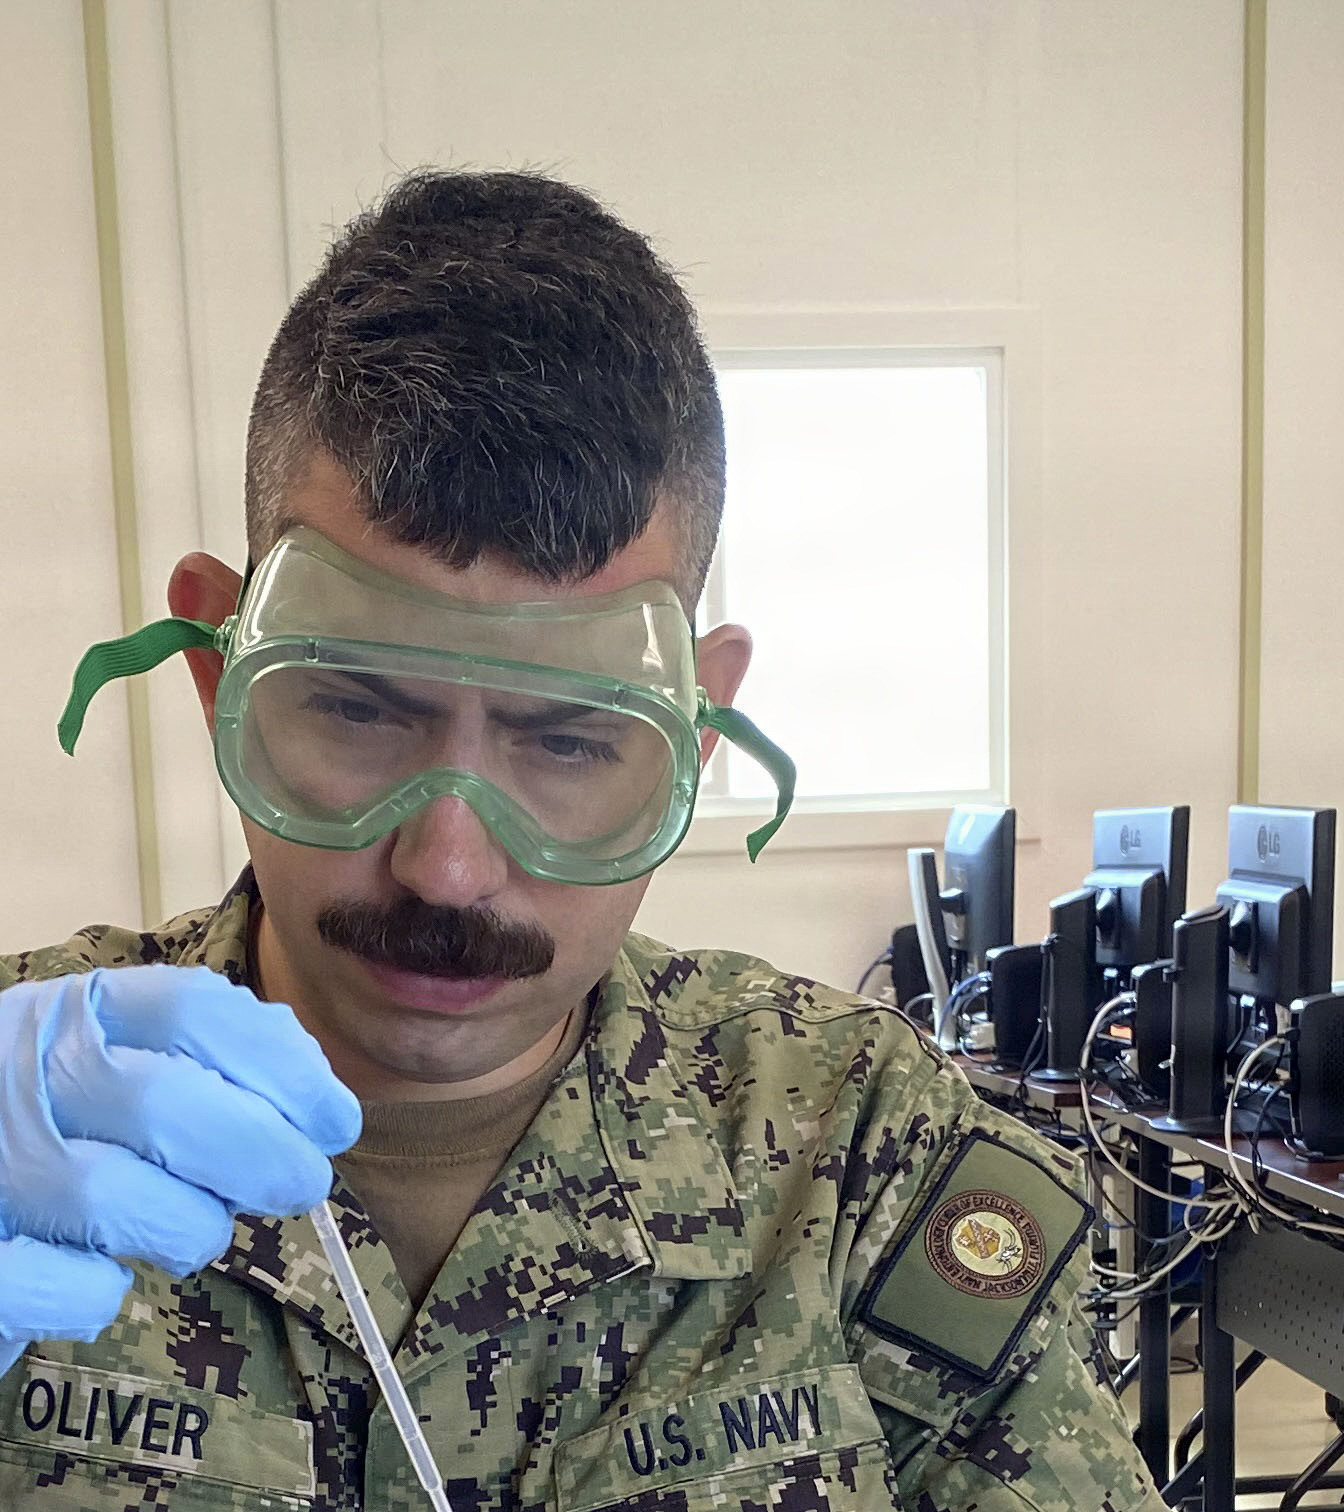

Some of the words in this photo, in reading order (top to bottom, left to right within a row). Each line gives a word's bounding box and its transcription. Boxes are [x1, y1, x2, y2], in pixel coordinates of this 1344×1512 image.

[23, 1379, 209, 1460] OLIVER
[624, 1414, 705, 1476] U.S.
[719, 1384, 822, 1453] NAVY
